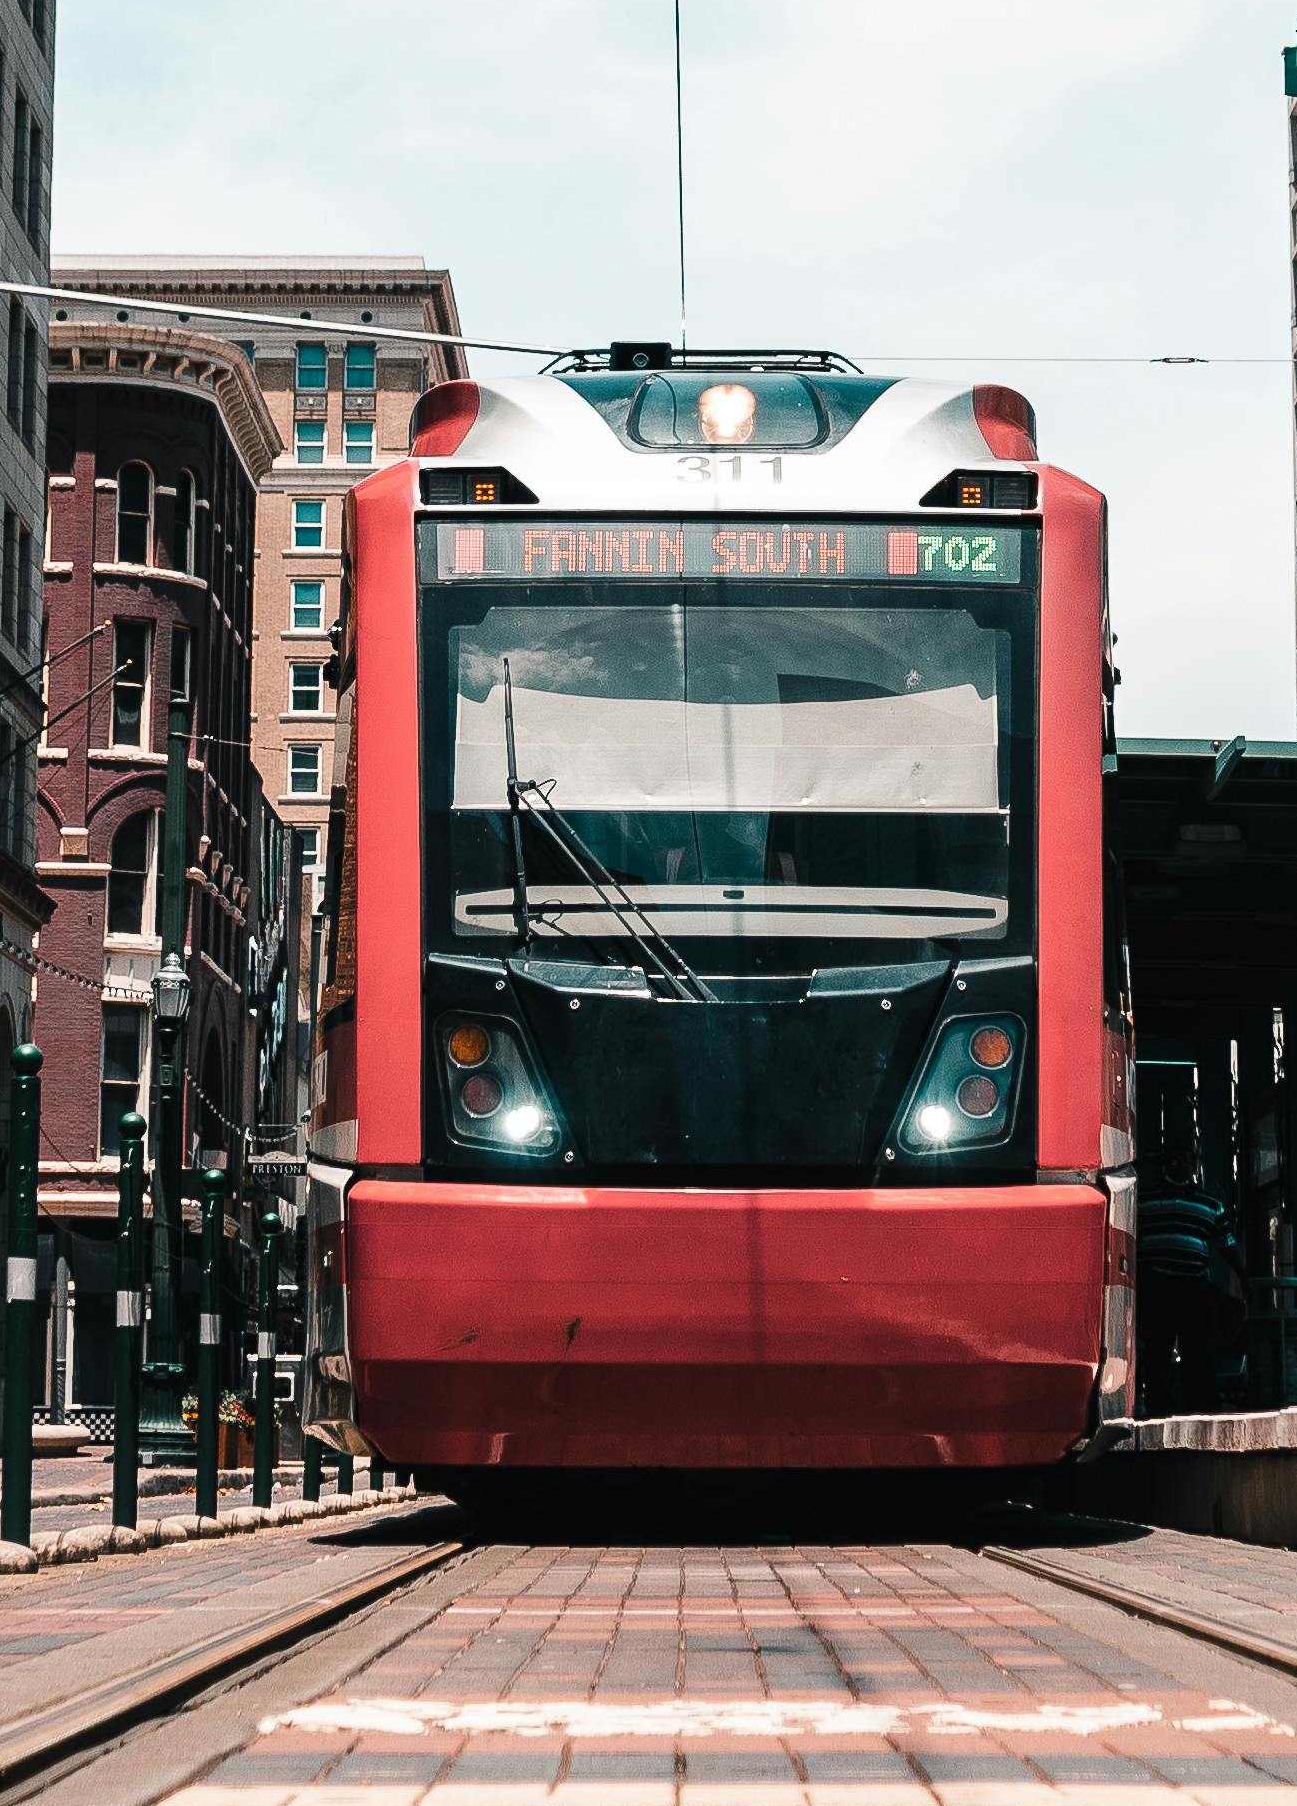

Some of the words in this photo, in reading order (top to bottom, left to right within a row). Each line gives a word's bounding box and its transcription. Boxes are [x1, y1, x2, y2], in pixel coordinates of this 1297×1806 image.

[676, 455, 783, 484] 311
[523, 529, 684, 573] FANNIN
[711, 531, 846, 574] SOUTH
[917, 535, 997, 572] 702
[252, 1164, 302, 1174] PRESTON
